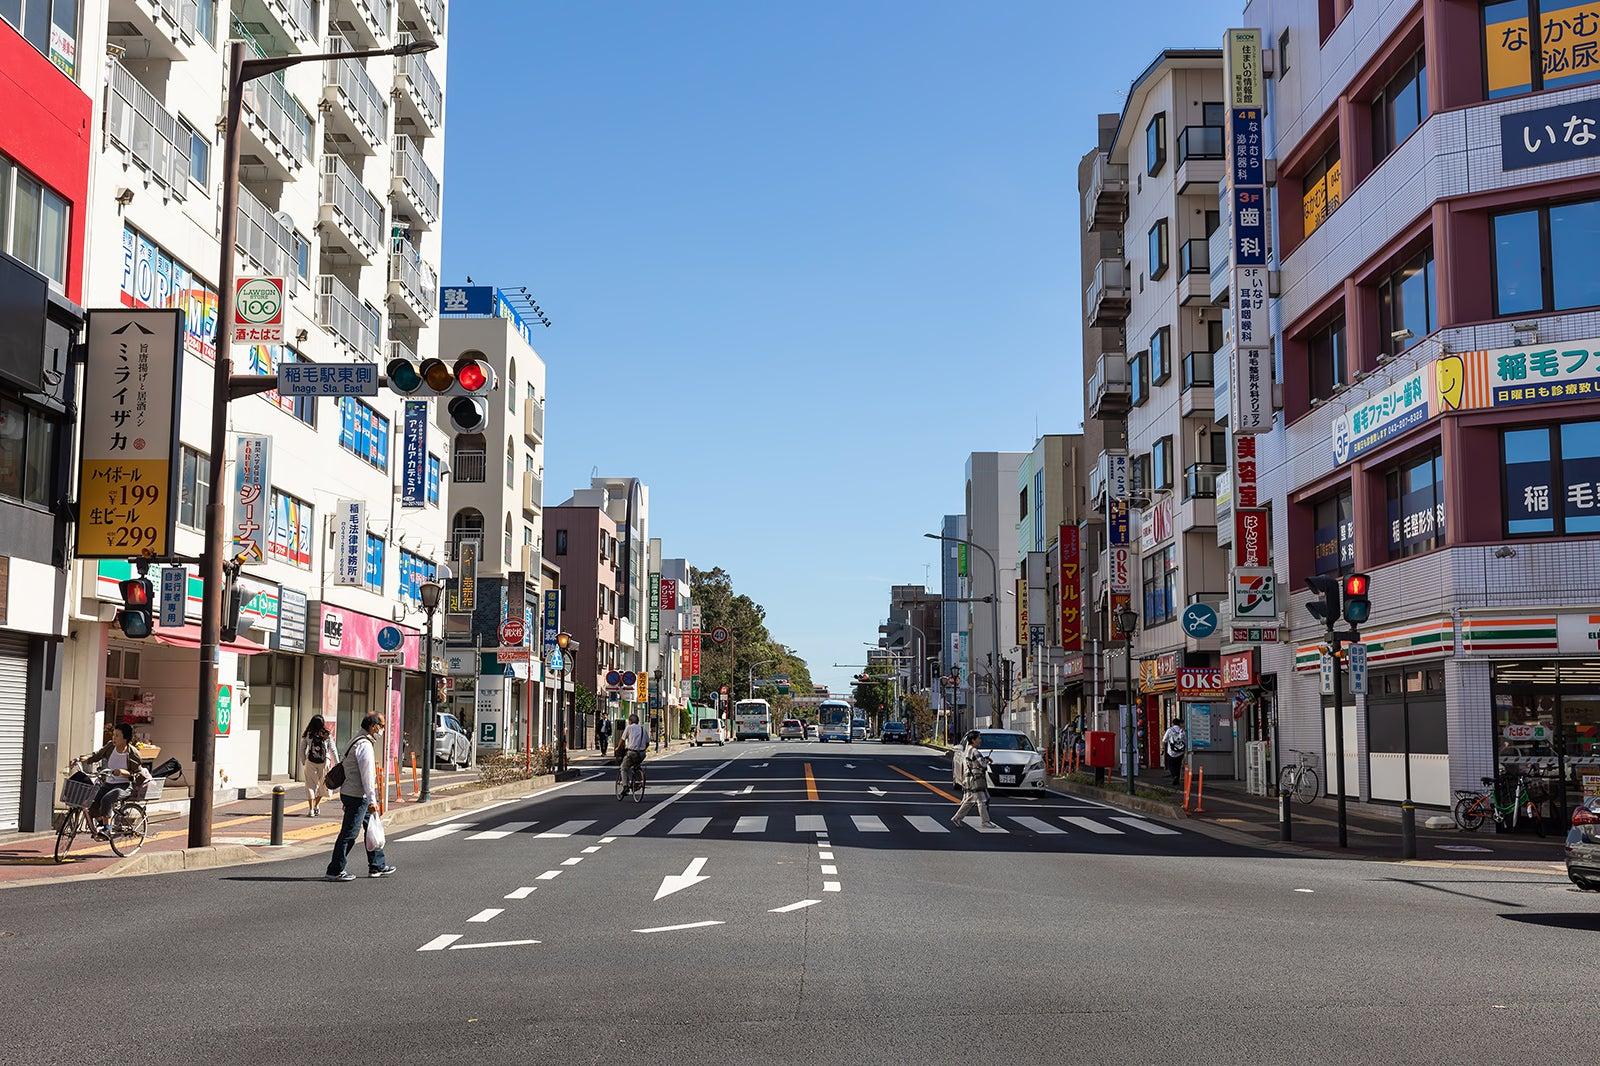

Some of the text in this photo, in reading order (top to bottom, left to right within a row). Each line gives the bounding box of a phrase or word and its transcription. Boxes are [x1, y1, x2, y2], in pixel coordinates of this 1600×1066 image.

[1236, 134, 1247, 180] 泌尿器科
[1248, 122, 1259, 168] なかむら
[1240, 208, 1260, 257] 歯科
[243, 301, 277, 316] 100
[1252, 278, 1263, 310] いなげ
[1240, 288, 1251, 342] 耳鼻咽喉科
[284, 367, 372, 383] 稲毛駅東側
[292, 384, 363, 394] Inage Sta. East
[1249, 350, 1260, 427] 稲毛整形外科クリニック
[109, 343, 131, 451] ミライザカ
[1353, 376, 1422, 435] 稲毛ファミリー歯科
[91, 465, 142, 483] ハイボール
[407, 419, 417, 495] アップルアカデミア
[1237, 436, 1257, 507] 美容室
[1524, 483, 1600, 513] 稲毛
[89, 507, 140, 525] 生ビール
[239, 484, 262, 561] ジーナス
[1153, 499, 1172, 543] OKS
[1392, 503, 1445, 543] 稲毛整形外科
[348, 504, 359, 576] 稲毛法律事務所
[1116, 549, 1128, 584] OKS
[165, 572, 173, 601] 自転車
[1062, 563, 1079, 645] マルサン
[167, 603, 176, 623] 専用
[714, 631, 726, 639] 40
[1263, 628, 1278, 640] ATM
[1181, 673, 1222, 689] OKS
[484, 724, 494, 735] P
[1508, 726, 1531, 737] たばこ
